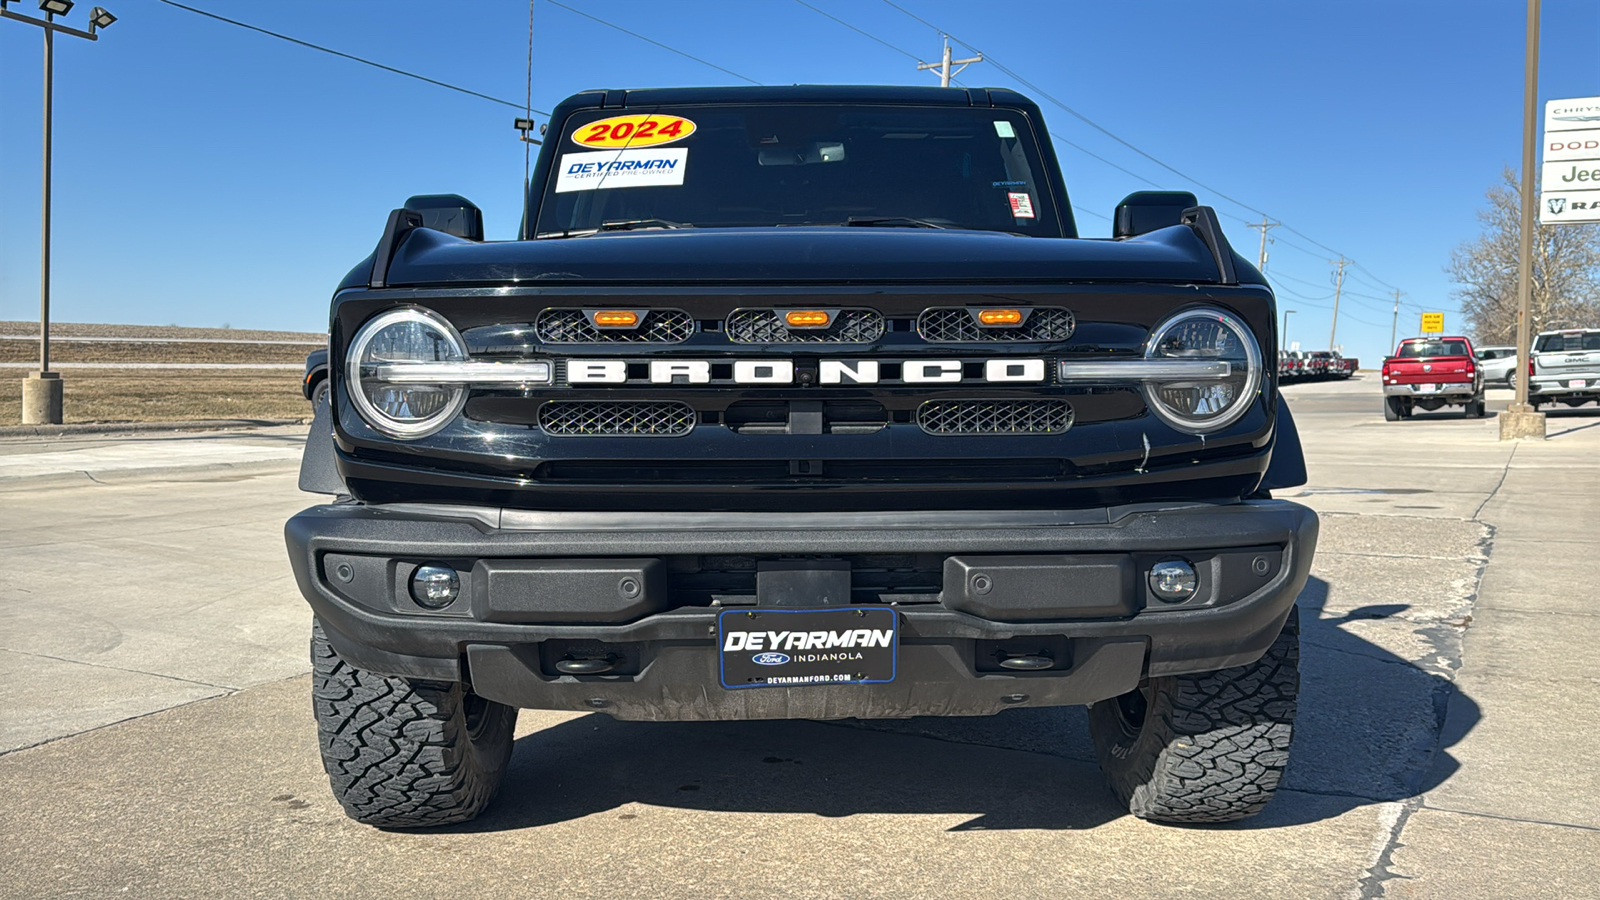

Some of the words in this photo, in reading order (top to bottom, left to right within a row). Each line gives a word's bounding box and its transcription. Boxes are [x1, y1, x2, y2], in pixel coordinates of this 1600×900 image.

[584, 120, 683, 142] 2024
[567, 159, 678, 174] DEYARMAN
[574, 171, 619, 179] CERTIFIED
[567, 359, 1045, 384] BRONCO
[723, 629, 893, 651] DEYARMAN
[759, 653, 782, 664] Ford
[794, 653, 863, 662] INDIANOLA
[767, 674, 851, 684] DEYARMANFORD.COM
